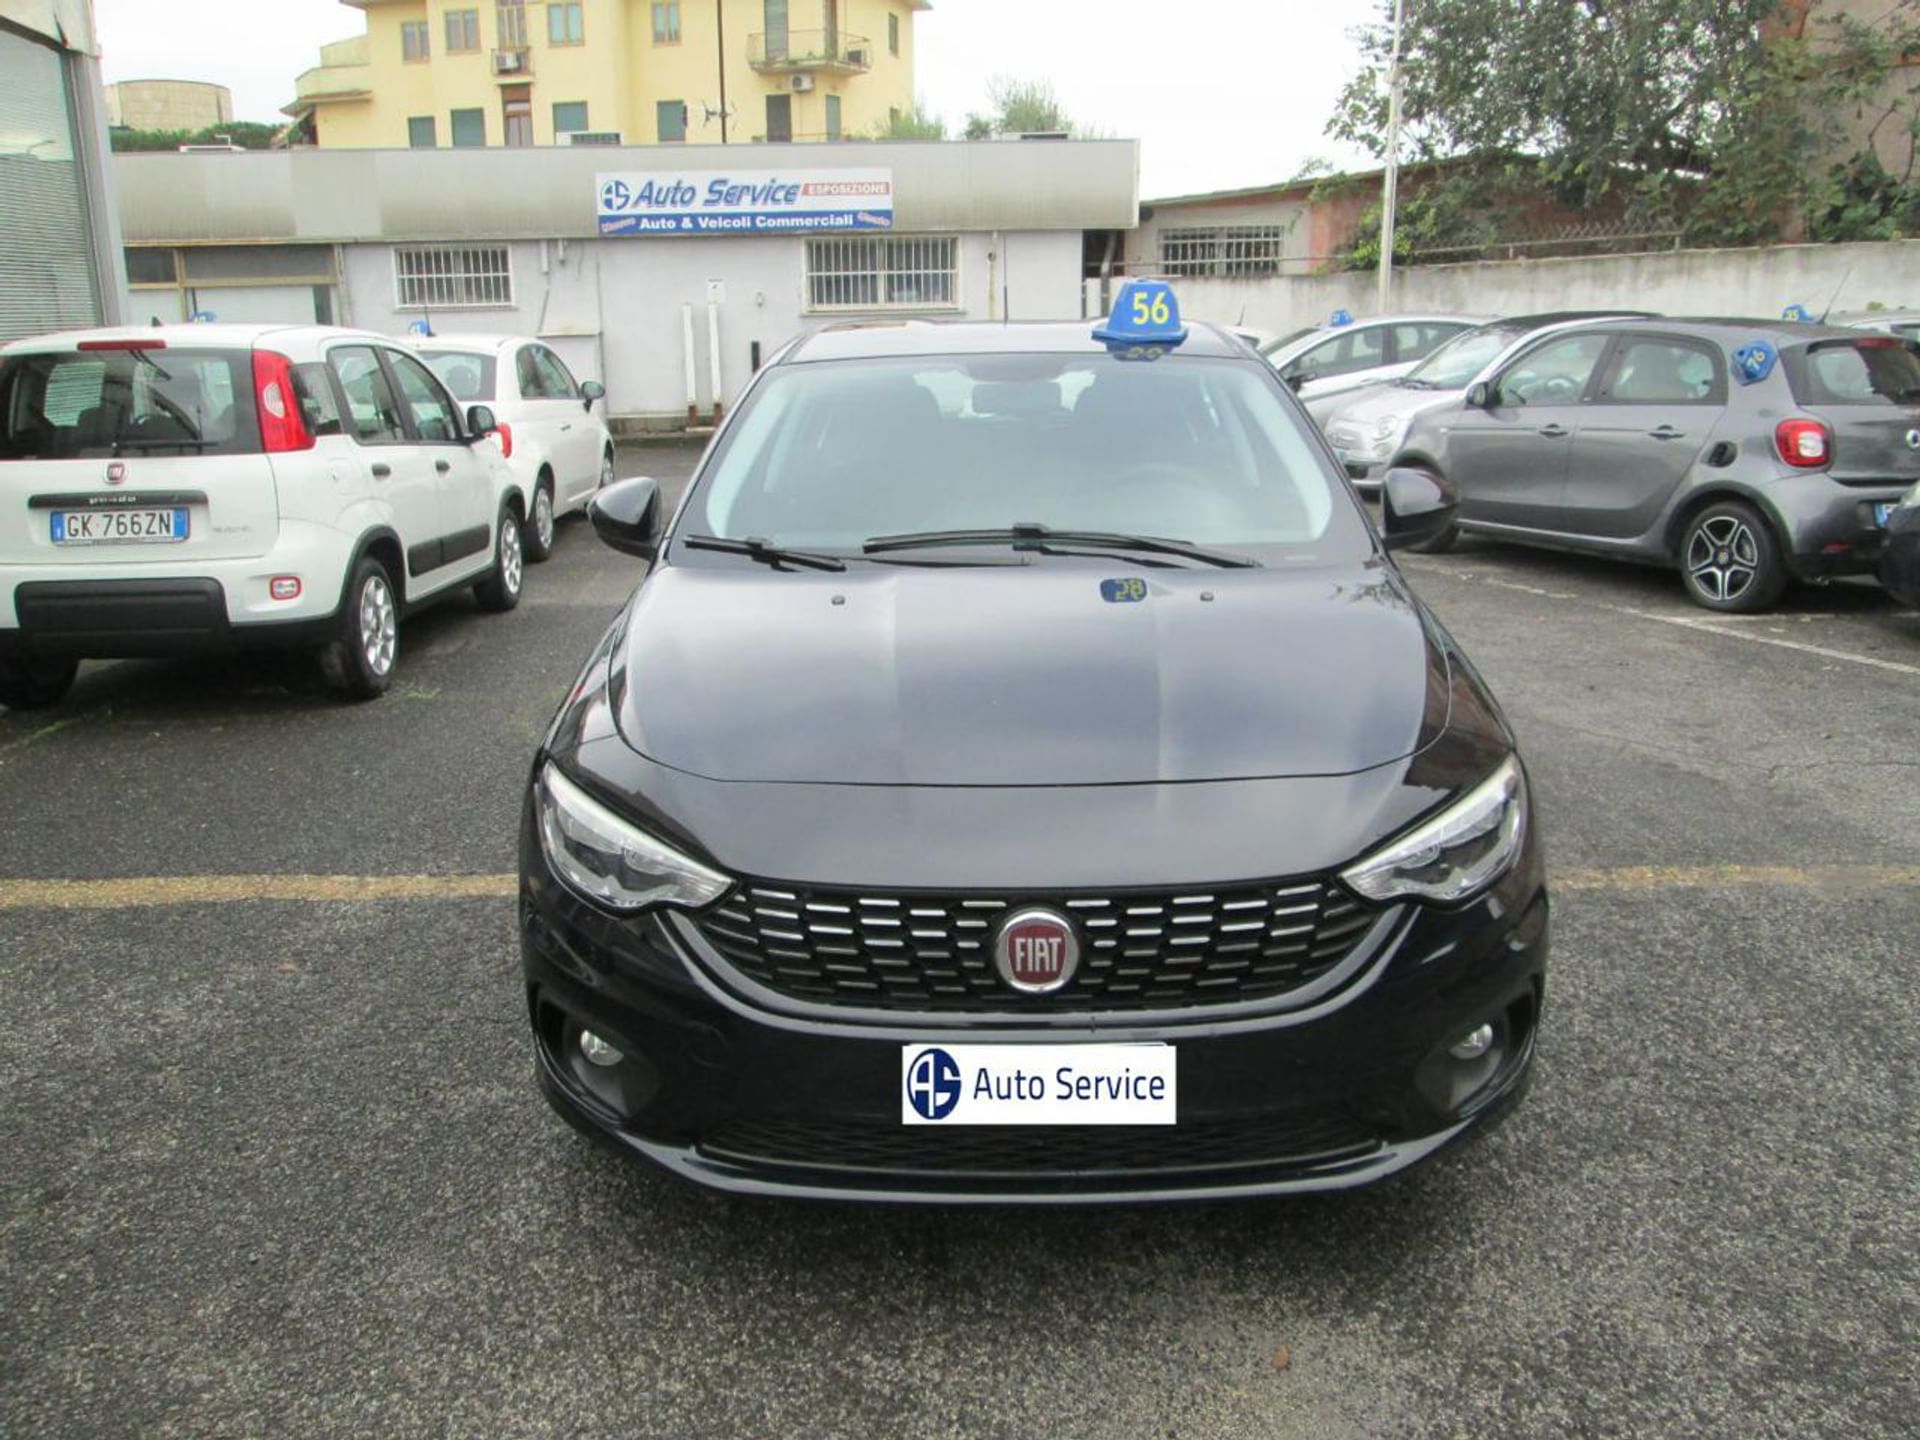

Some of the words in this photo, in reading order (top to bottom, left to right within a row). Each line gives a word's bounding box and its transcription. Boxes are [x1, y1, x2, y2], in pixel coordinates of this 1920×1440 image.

[632, 179, 697, 208] Auto
[703, 177, 800, 206] Service
[808, 182, 887, 195] ESPOSIZIONE
[639, 216, 677, 230] Auto
[681, 216, 694, 229] &
[698, 214, 751, 229] Veicoli
[755, 213, 854, 228] Commerciali
[1132, 291, 1170, 325] 56
[67, 515, 93, 538] GK
[102, 511, 171, 536] 766ZN
[1014, 936, 1063, 973] FIAT
